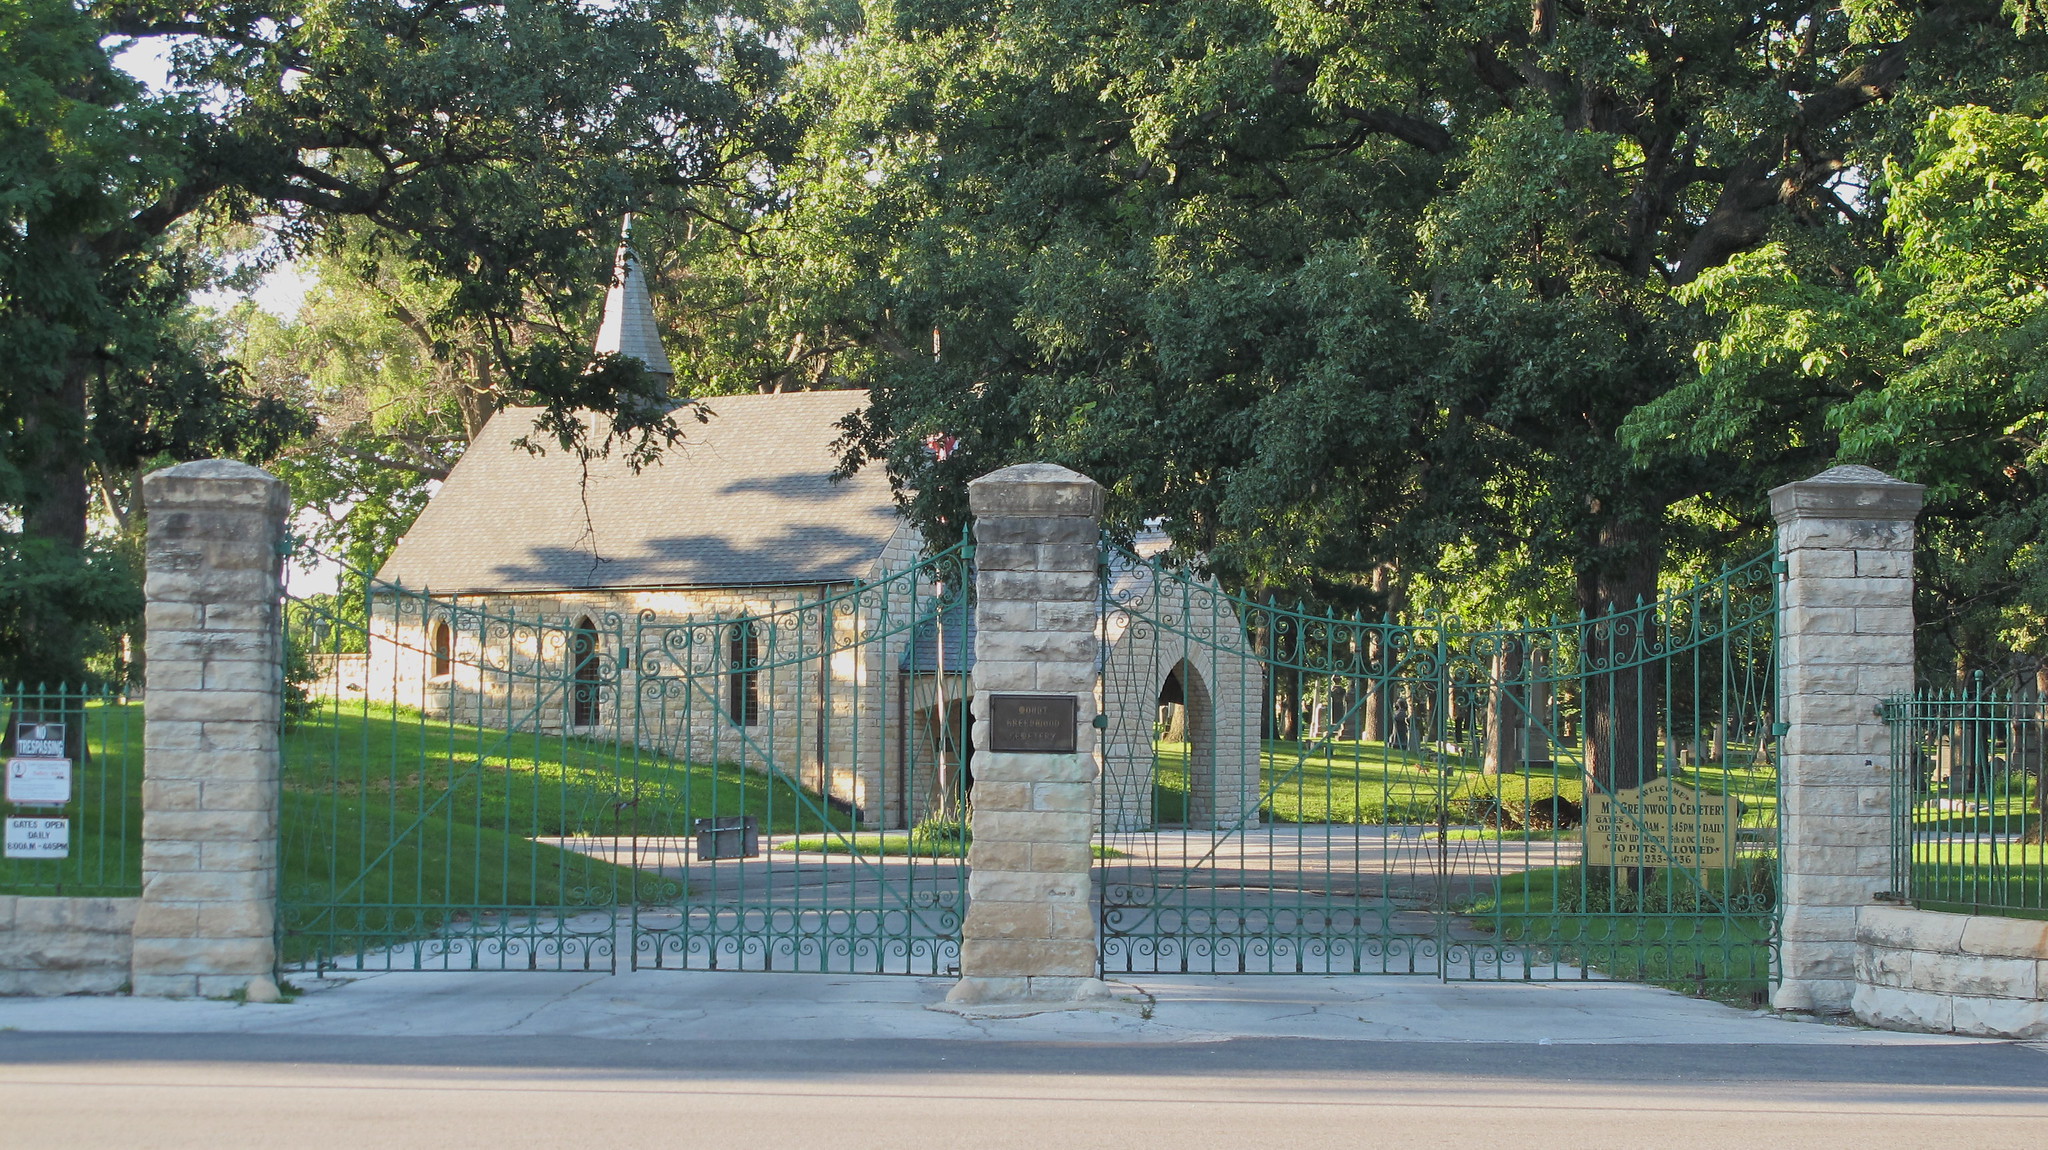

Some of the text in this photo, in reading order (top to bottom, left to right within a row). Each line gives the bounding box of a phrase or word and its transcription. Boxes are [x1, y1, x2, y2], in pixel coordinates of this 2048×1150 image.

[36, 725, 47, 740] NO
[19, 740, 65, 755] TRESPASSING
[1601, 802, 1617, 814] M.
[1620, 802, 1677, 815] GRENWOD
[1596, 816, 1624, 824] GAES
[1632, 821, 1659, 832] 8:0AM
[1668, 823, 1694, 833] :45PM
[1606, 834, 1628, 842] CEAN
